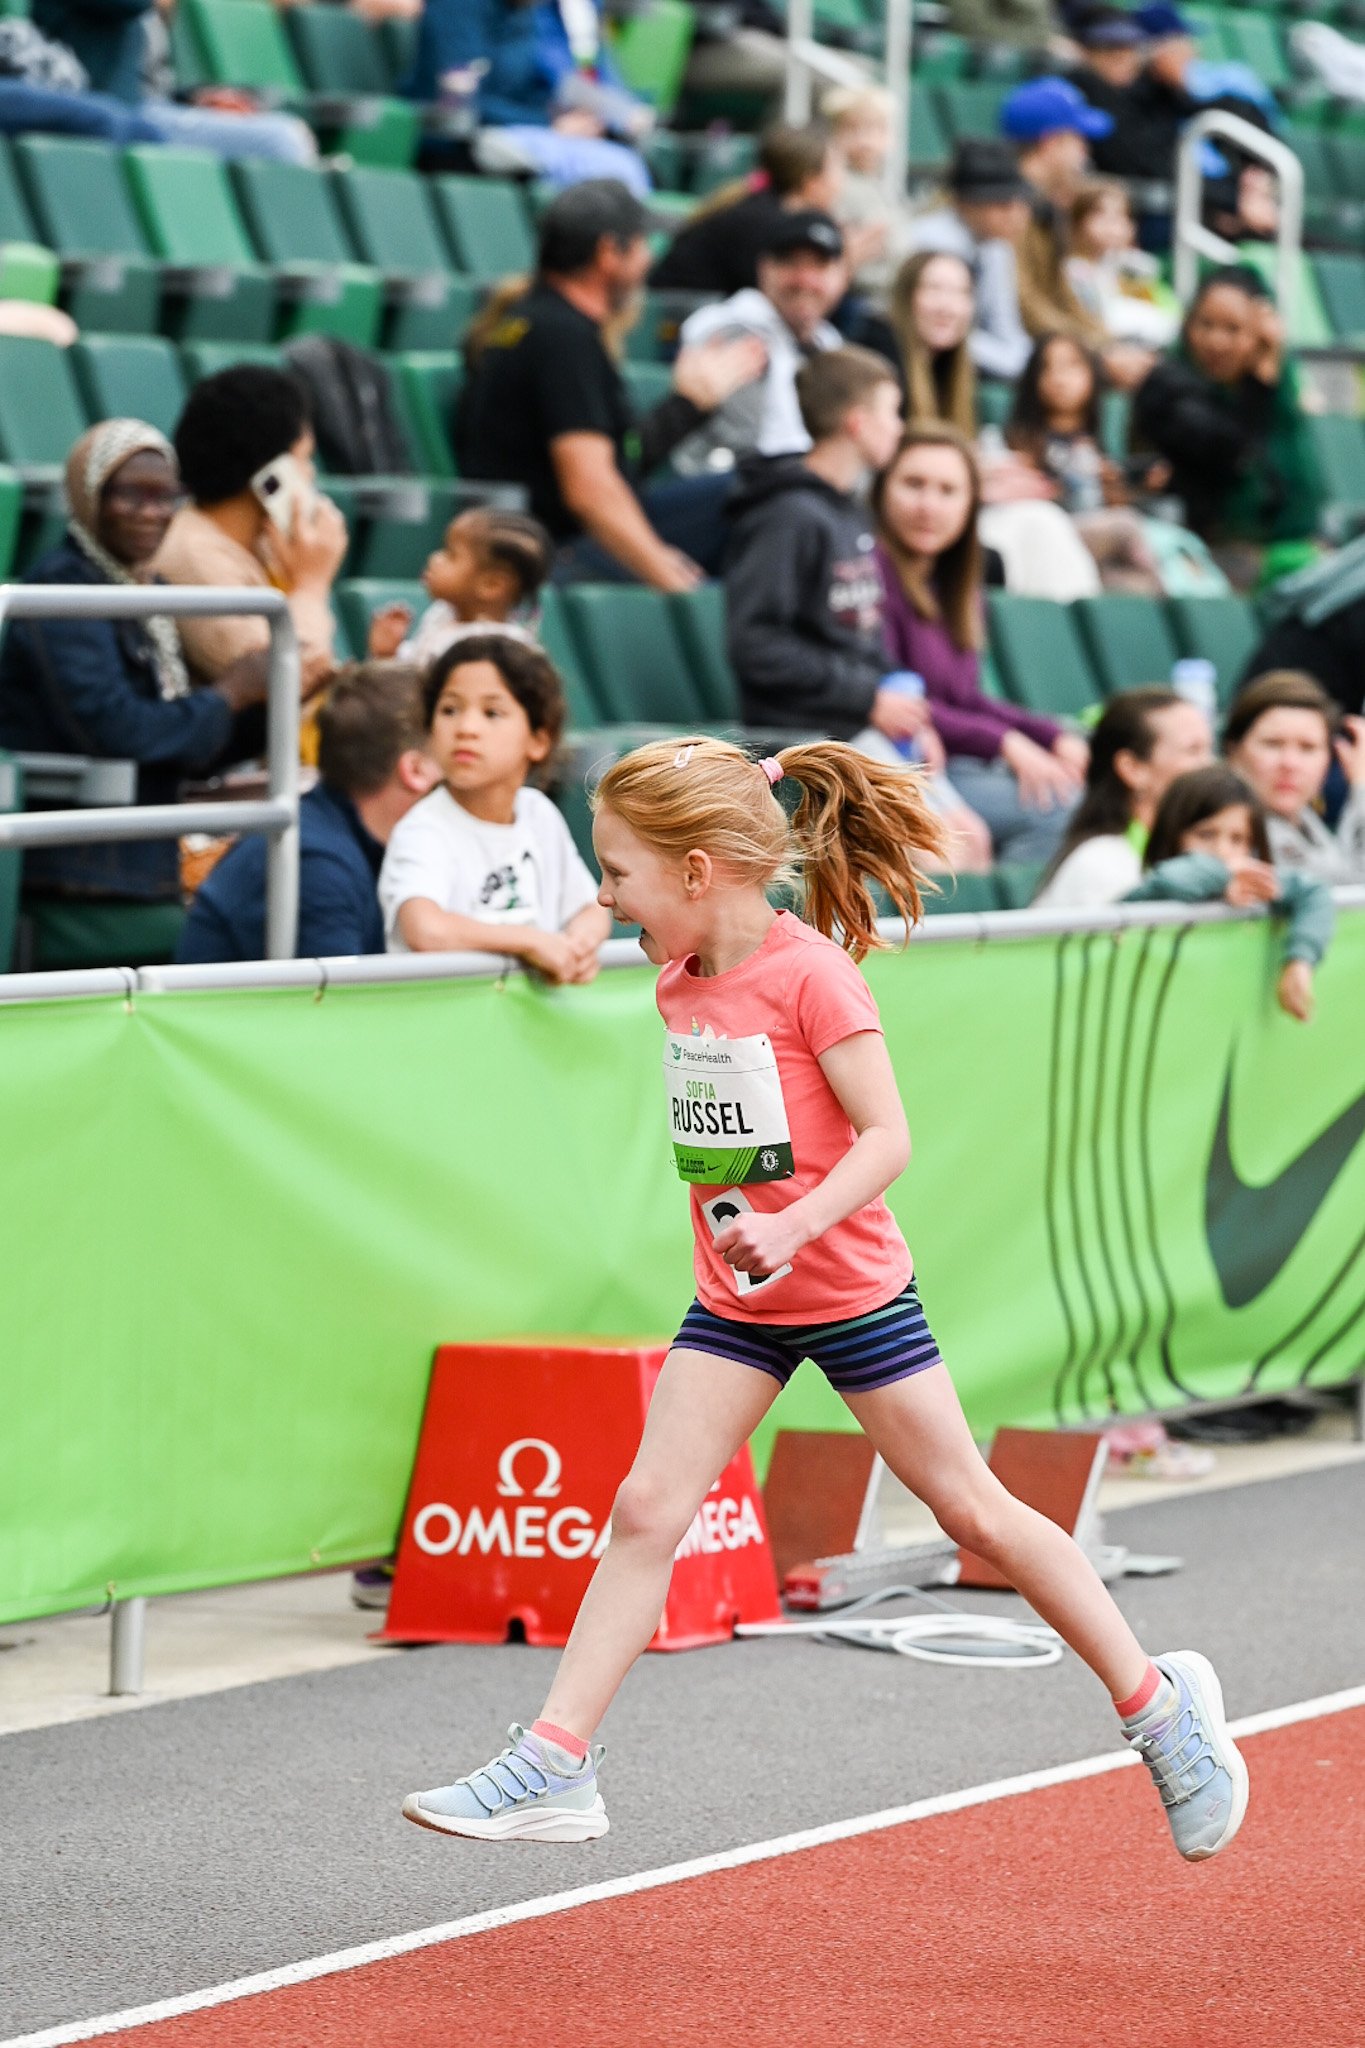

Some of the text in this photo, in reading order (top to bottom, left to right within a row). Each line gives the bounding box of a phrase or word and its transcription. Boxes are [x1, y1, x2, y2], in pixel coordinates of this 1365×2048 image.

[683, 1048, 732, 1064] PeaceHealth
[686, 1080, 717, 1100] SOFIA
[672, 1097, 754, 1135] RUSSEL
[674, 1495, 765, 1561] MEGA
